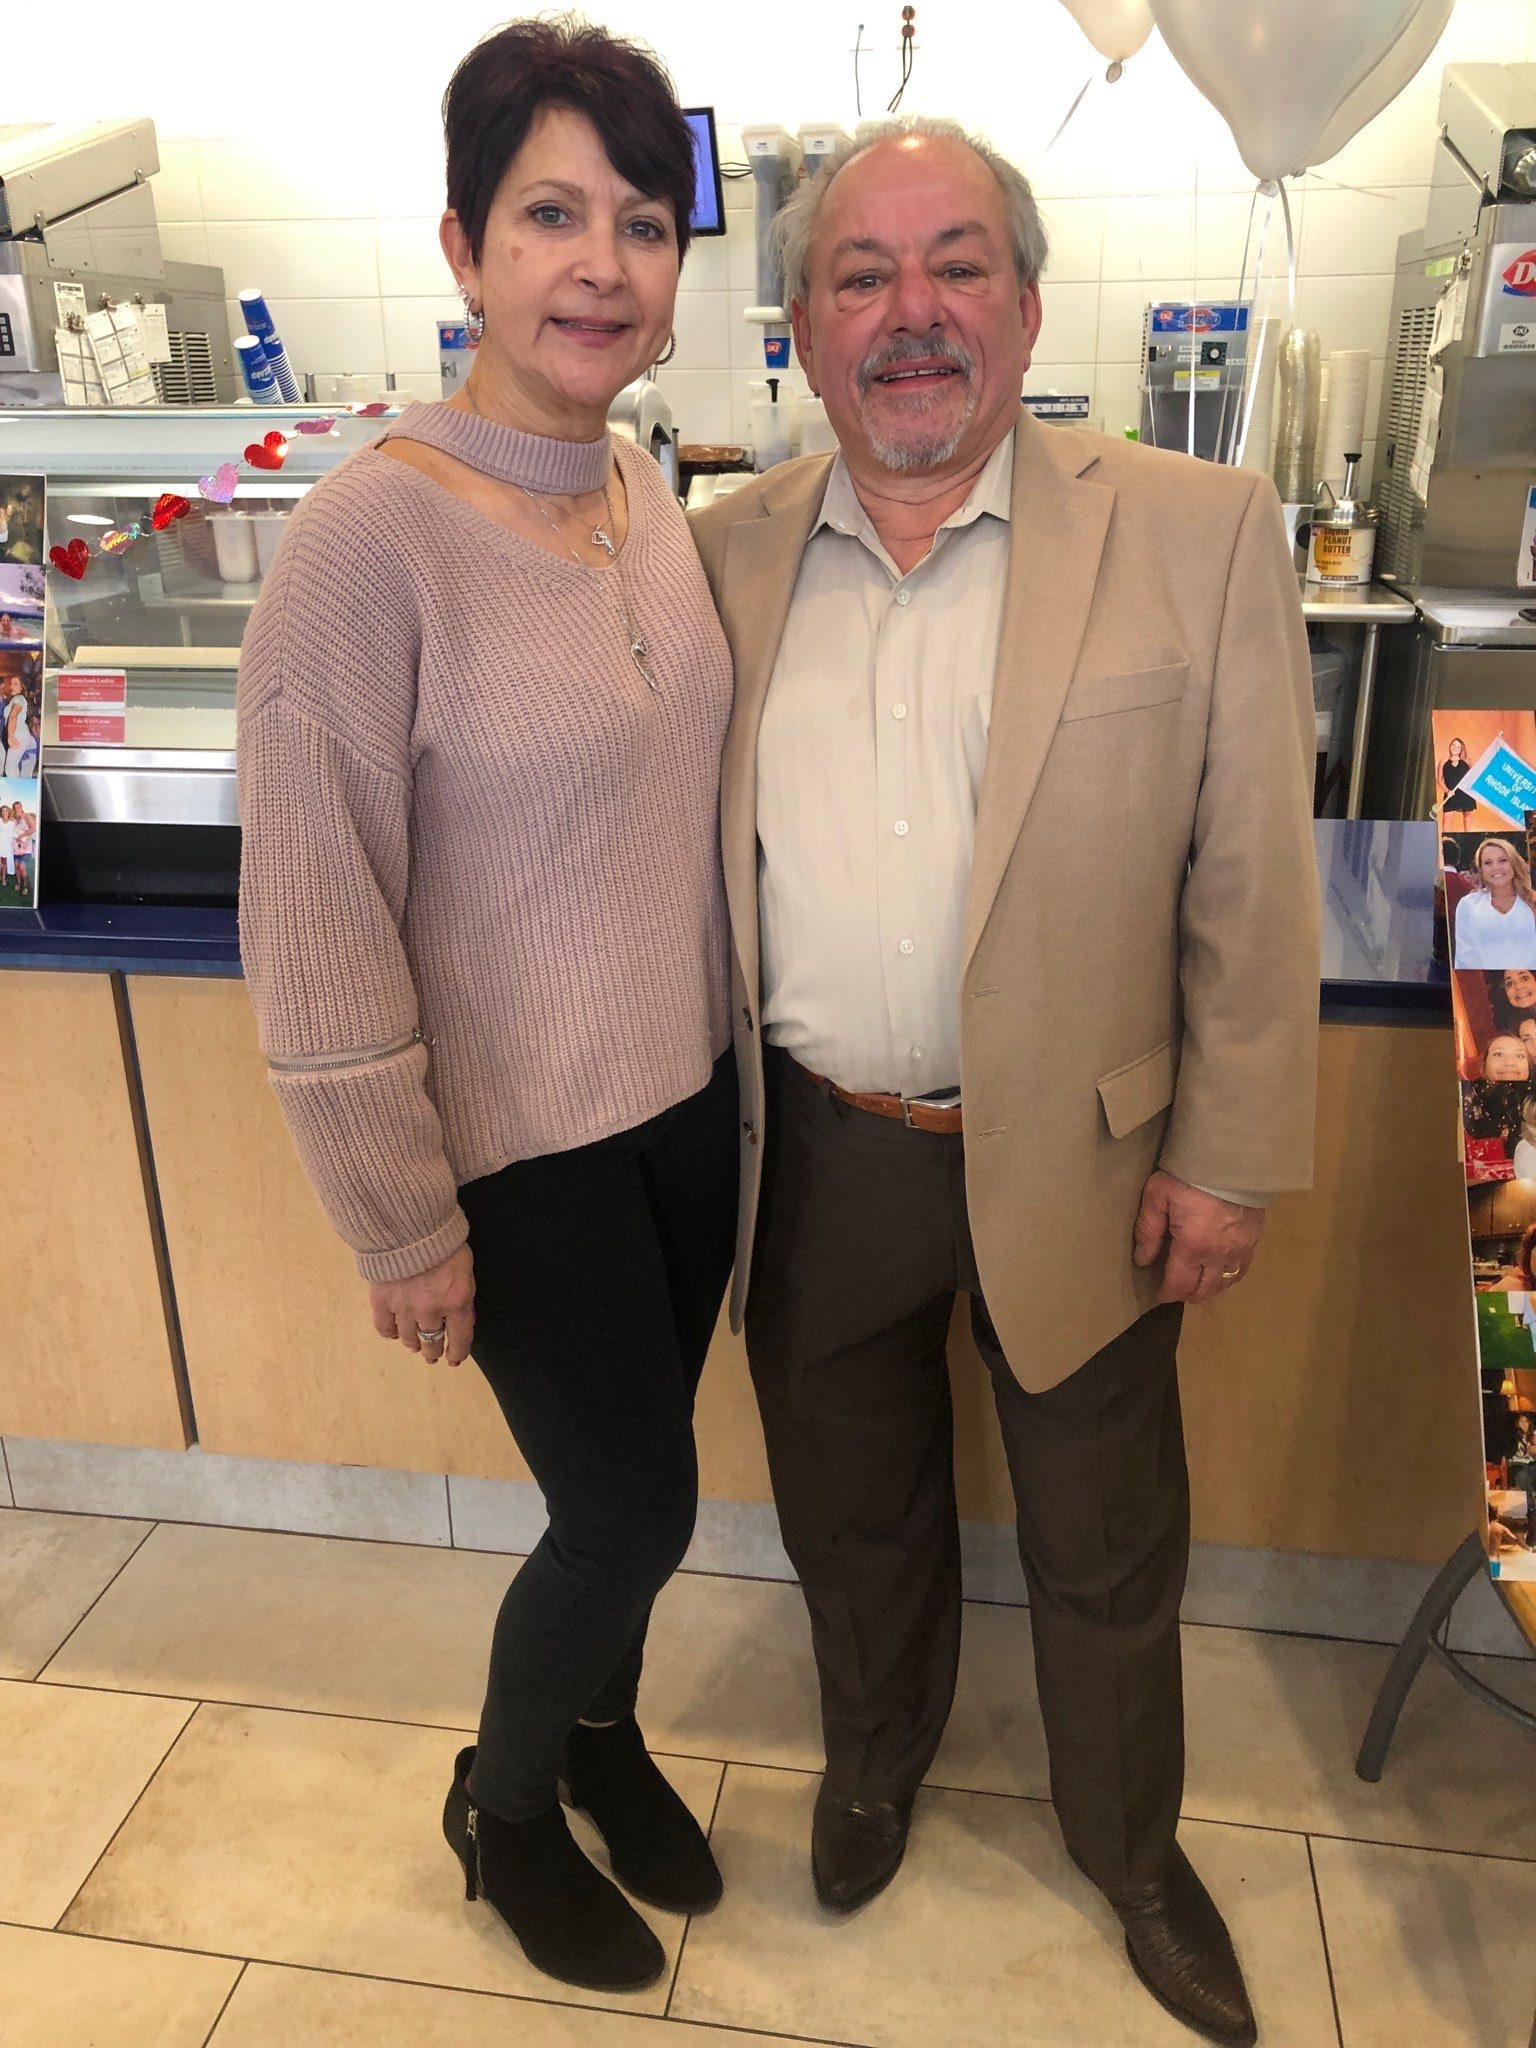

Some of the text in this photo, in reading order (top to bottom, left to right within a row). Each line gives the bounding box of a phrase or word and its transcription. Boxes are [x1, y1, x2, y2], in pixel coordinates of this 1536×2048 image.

[1324, 536, 1352, 545] PEANUT
[1322, 545, 1351, 553] BUTTER
[1502, 762, 1536, 795] UNIVERSIT
[1484, 774, 1511, 798] RHODE
[1511, 783, 1523, 794] OF
